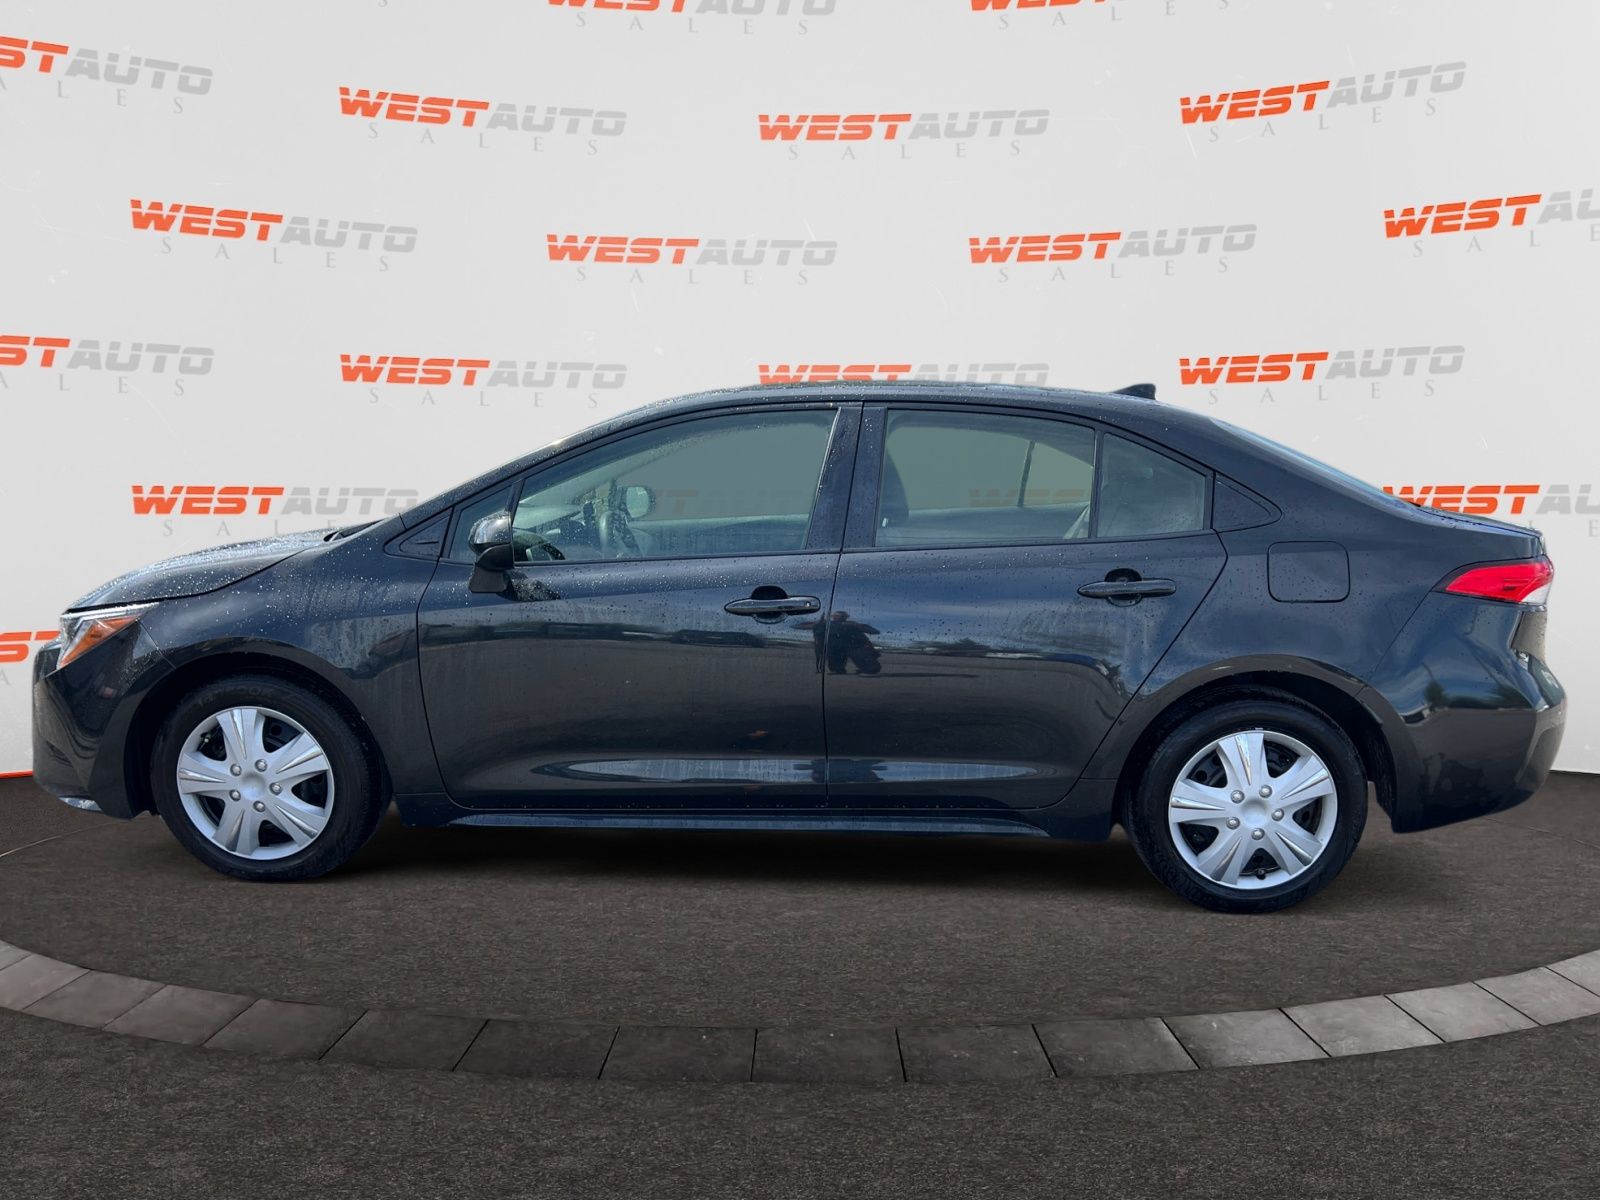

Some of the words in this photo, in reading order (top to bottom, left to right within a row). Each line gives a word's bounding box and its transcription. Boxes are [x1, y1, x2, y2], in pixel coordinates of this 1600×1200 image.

[576, 12, 808, 35] SALES
[1209, 98, 1436, 142] SALES
[369, 123, 597, 155] SALES
[789, 139, 1020, 160] SALES
[161, 237, 388, 272] SALES
[577, 266, 808, 285] SALES
[999, 256, 1227, 283] SALES
[370, 387, 597, 408] SALES
[1209, 379, 1434, 405] SALES
